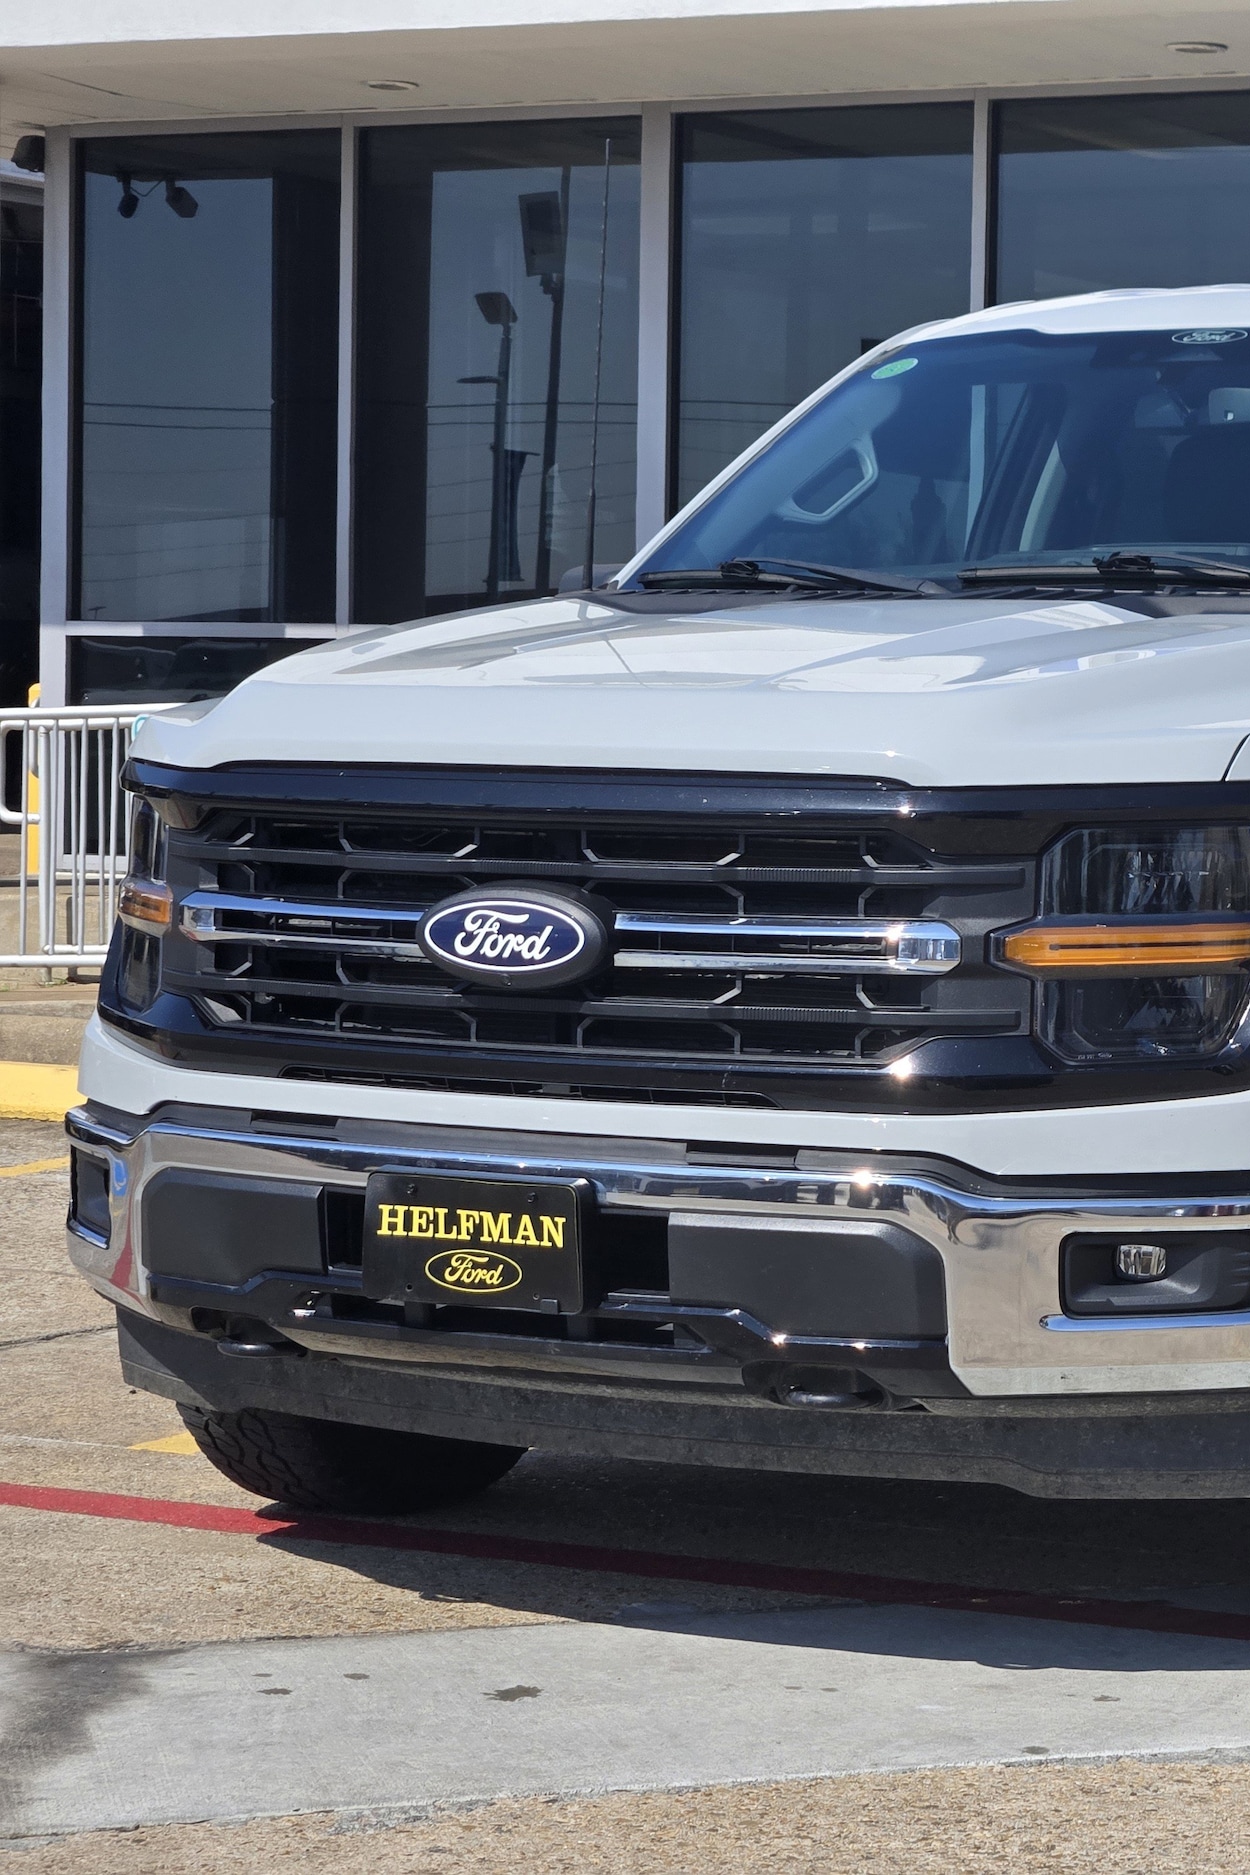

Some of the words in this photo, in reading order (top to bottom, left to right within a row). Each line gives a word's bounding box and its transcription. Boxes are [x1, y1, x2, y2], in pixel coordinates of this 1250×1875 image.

[454, 909, 554, 960] Ford
[376, 1204, 566, 1248] HELFMAN
[444, 1253, 504, 1285] Ford
